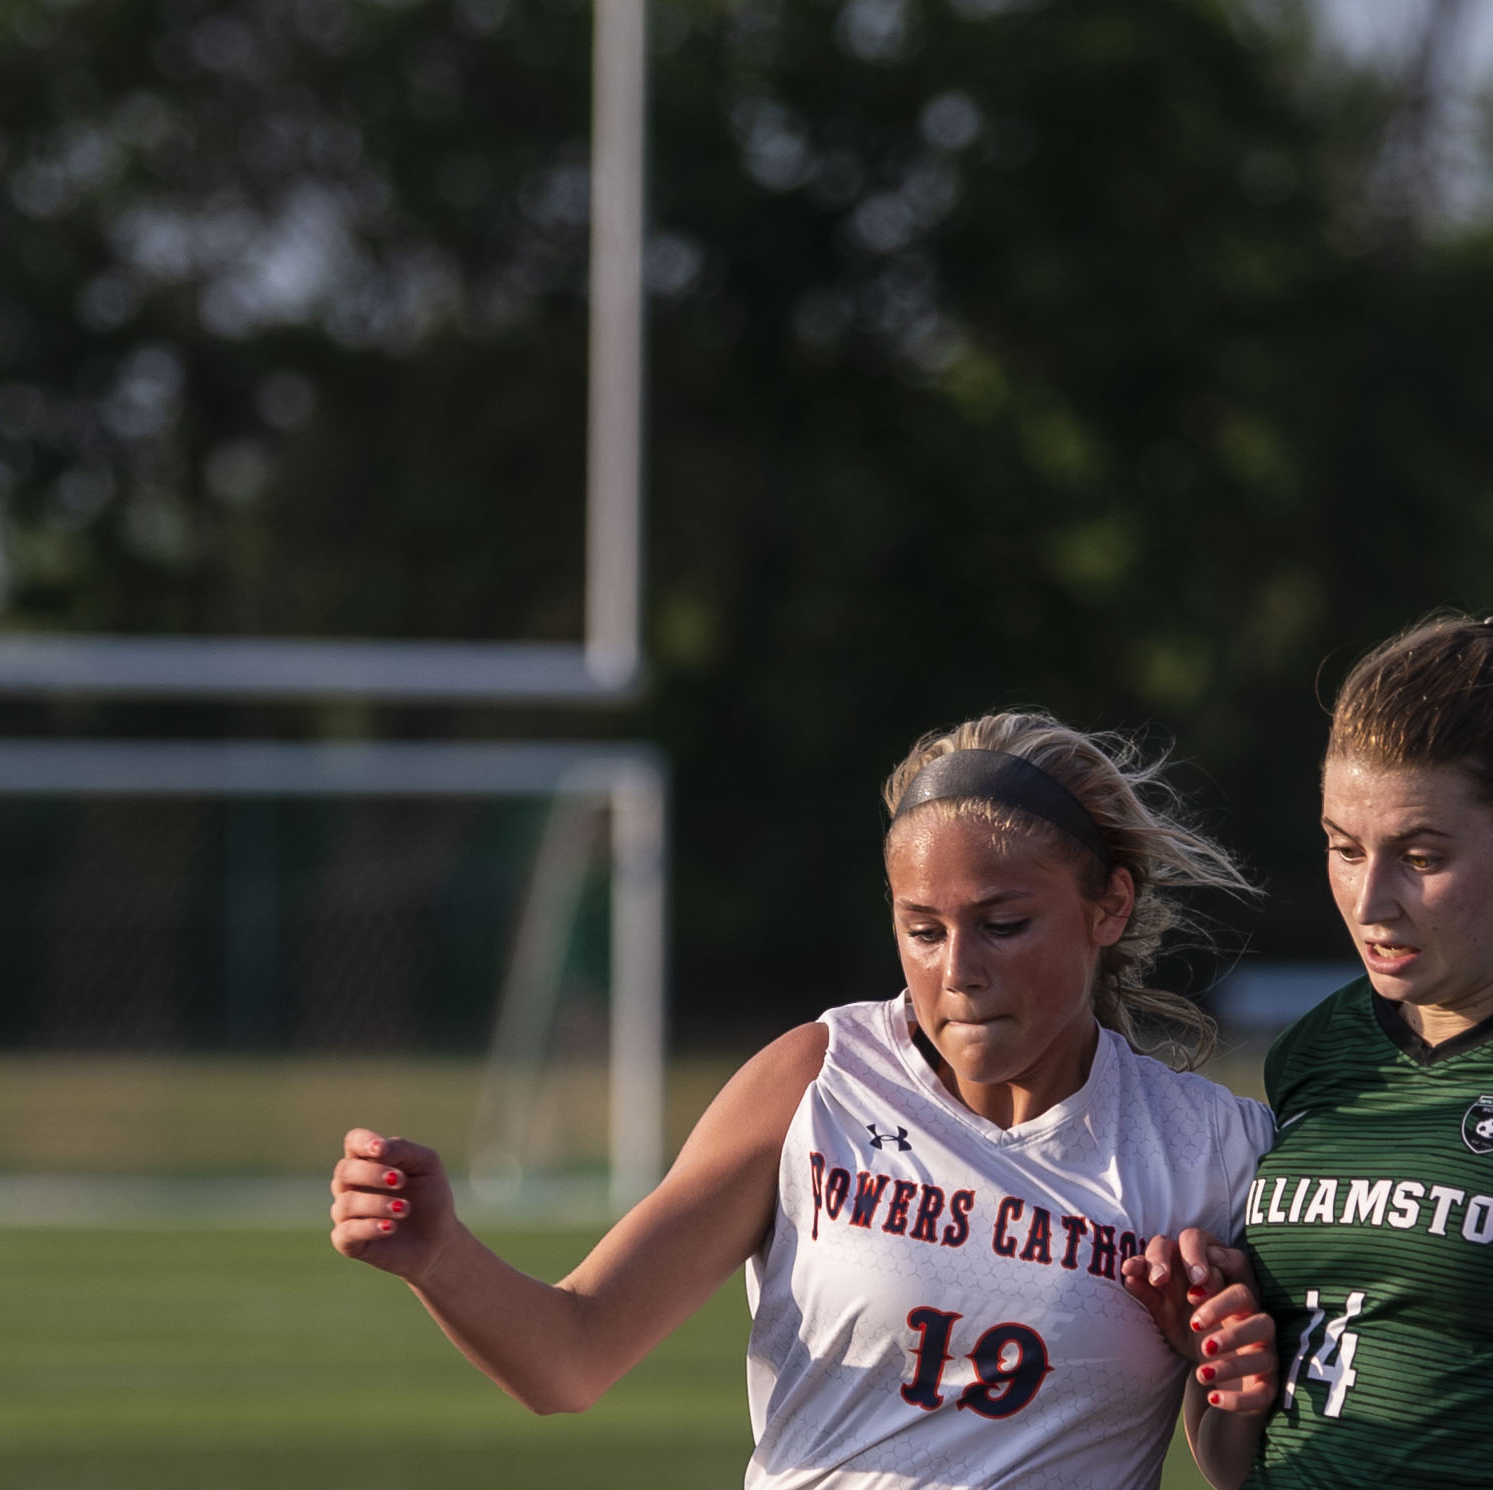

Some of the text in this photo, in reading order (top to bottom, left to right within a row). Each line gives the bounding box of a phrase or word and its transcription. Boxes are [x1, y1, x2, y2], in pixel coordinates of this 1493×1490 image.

[810, 1152, 1147, 1287] POWERS CATHO
[901, 1306, 1054, 1419] 19
[1283, 1290, 1366, 1418] 14
